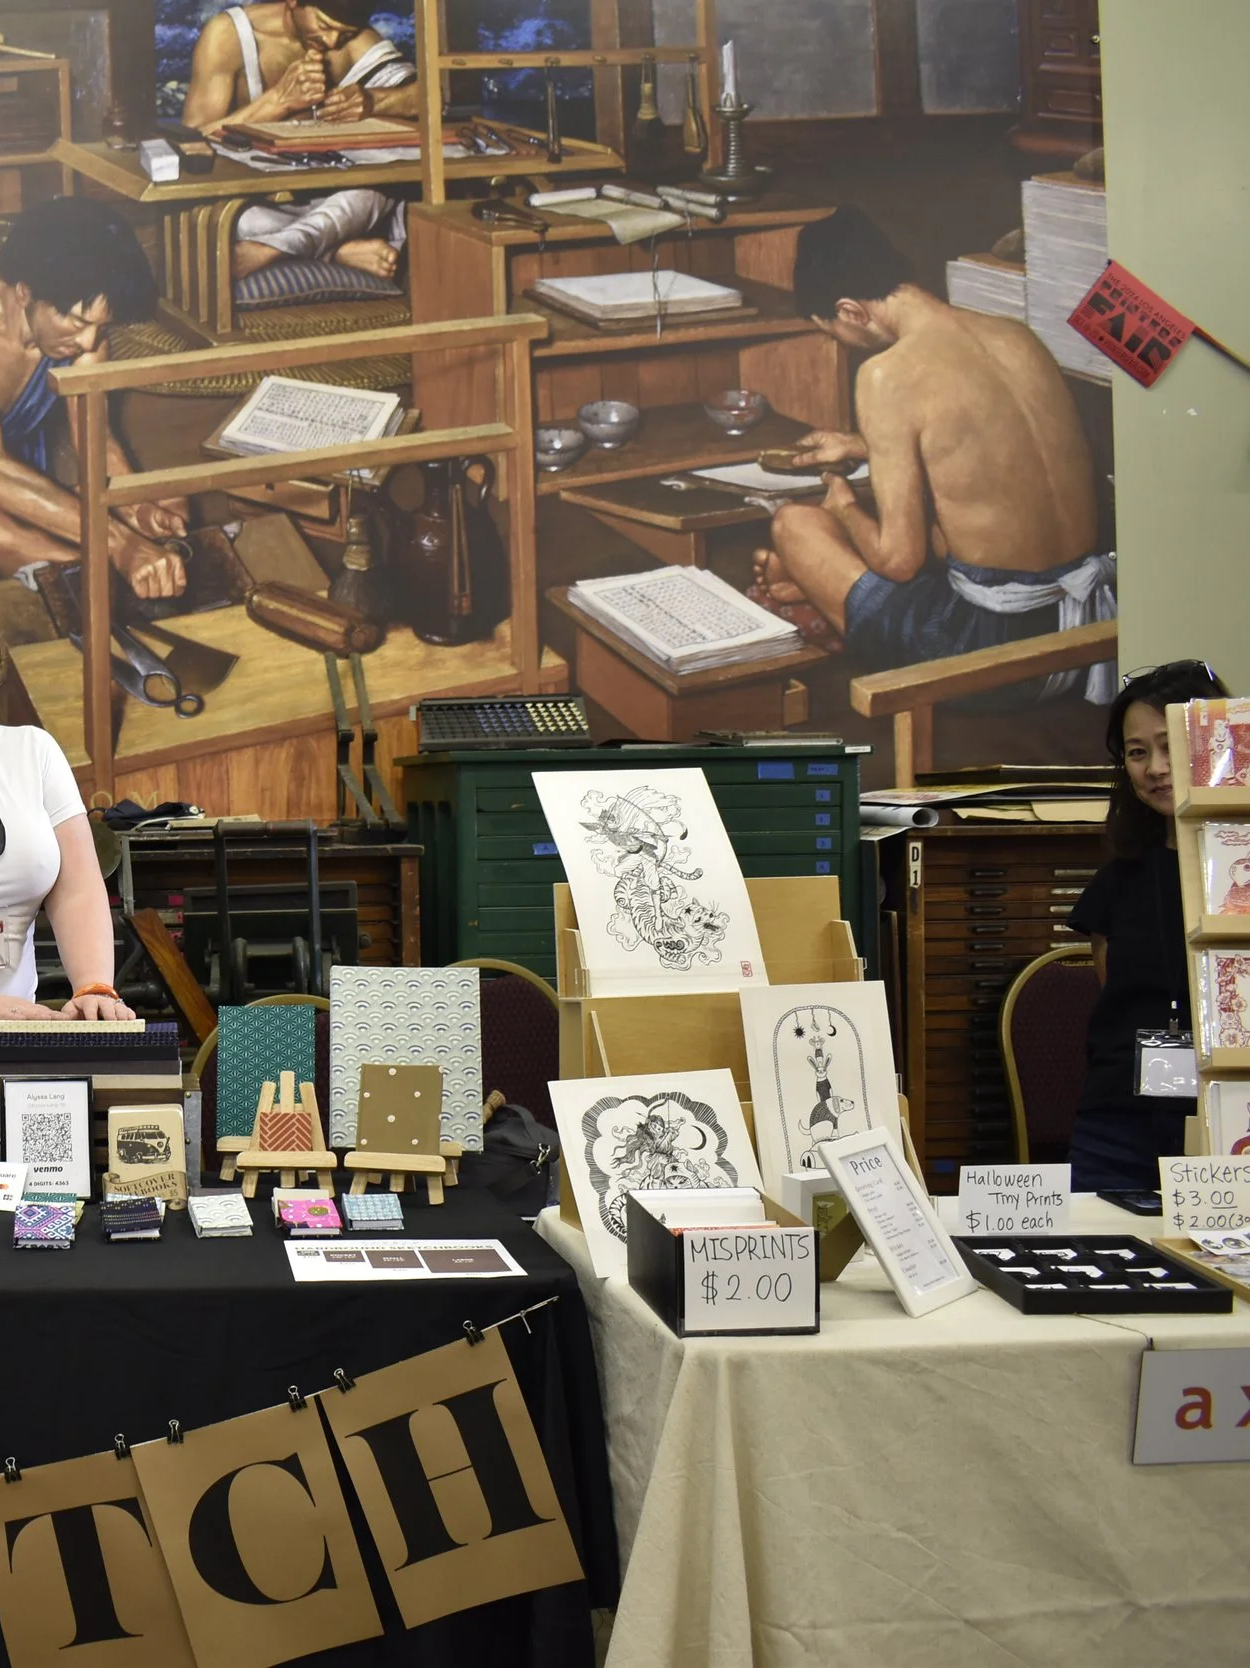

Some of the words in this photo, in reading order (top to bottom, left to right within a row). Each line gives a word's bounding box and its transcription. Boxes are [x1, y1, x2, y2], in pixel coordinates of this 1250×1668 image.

[1101, 280, 1183, 347] PRINTERS
[1080, 291, 1172, 376] FAIR
[1151, 310, 1188, 339] ANGELES
[27, 1093, 47, 1102] Alyssa
[49, 1093, 65, 1101] Lang
[33, 1165, 63, 1174] venmo
[849, 1156, 882, 1175] Price
[1170, 1162, 1250, 1184] Stickers
[114, 1173, 175, 1192] SOFTCOVER
[966, 1170, 1043, 1188] Halloween
[1026, 1190, 1063, 1208] Prints
[1172, 1189, 1234, 1208] $3.00
[965, 1210, 1014, 1233] $1.00
[1021, 1213, 1054, 1230] each
[690, 1233, 810, 1262] MISPRINTS
[700, 1271, 792, 1305] $2.00
